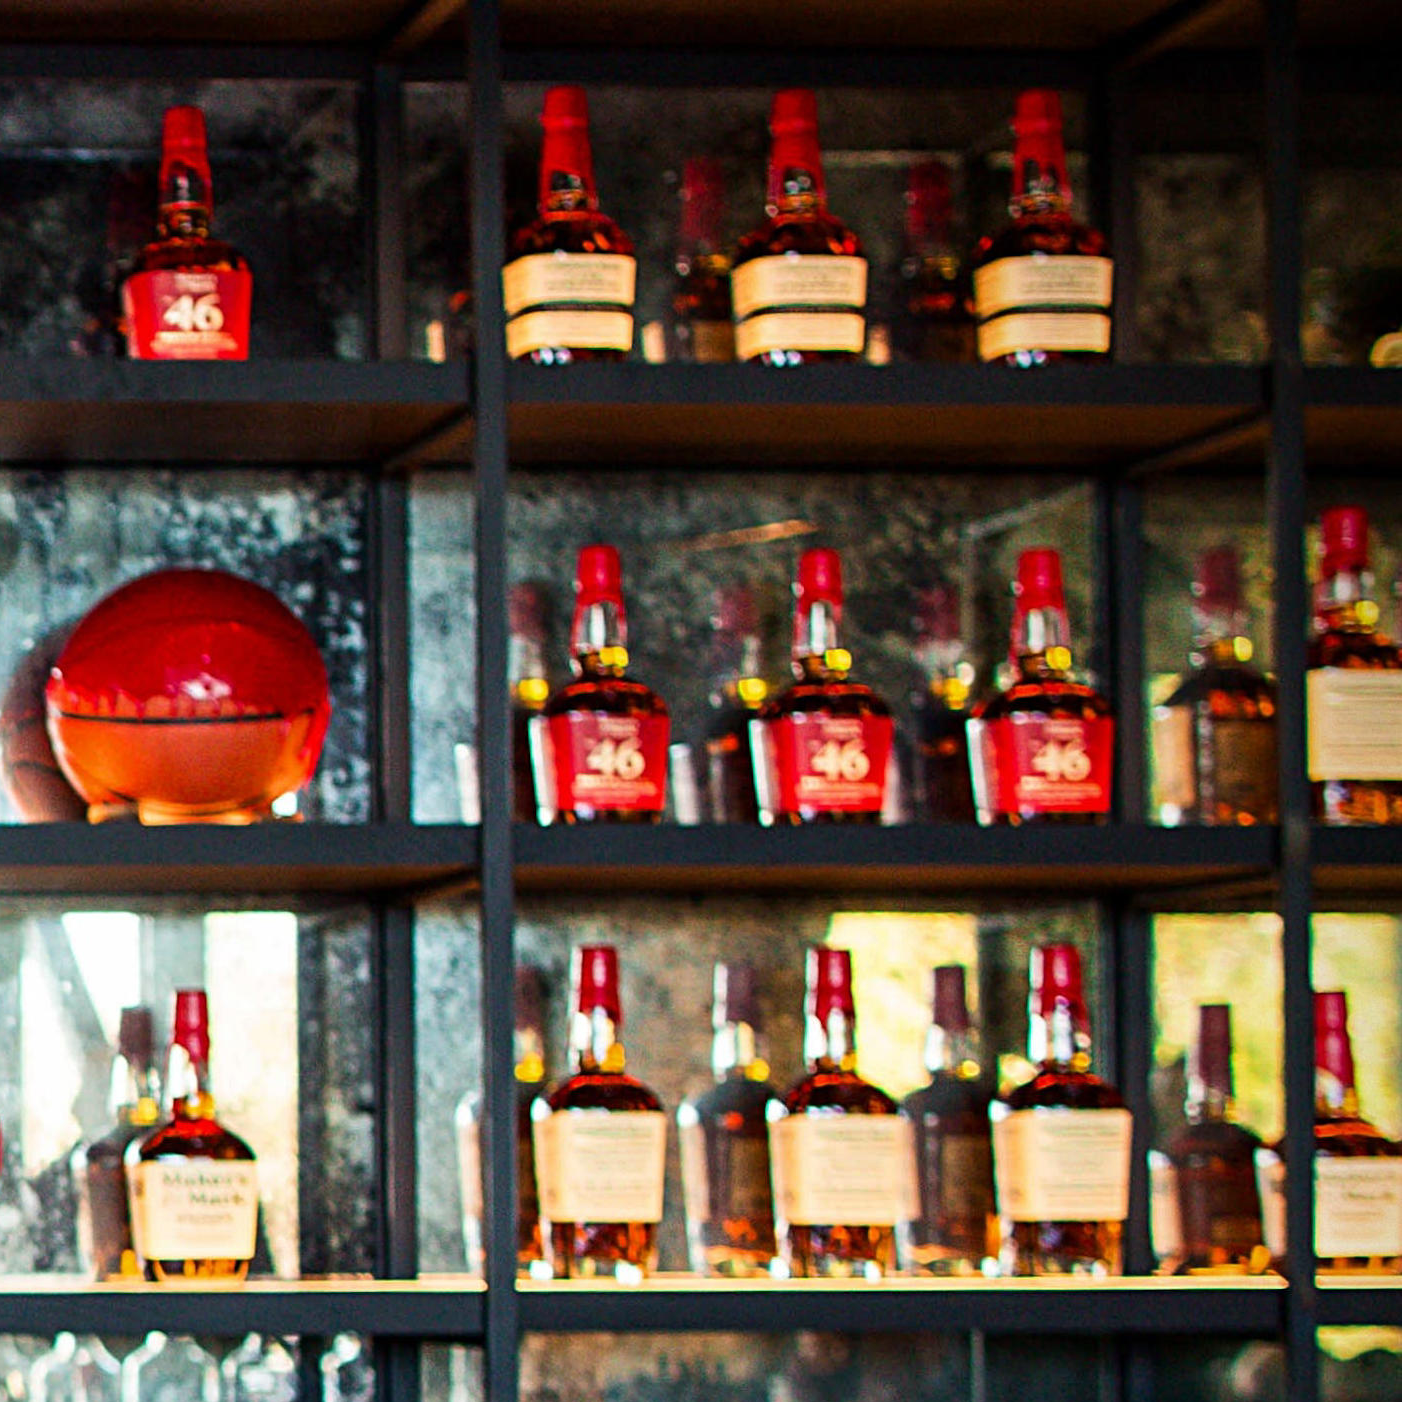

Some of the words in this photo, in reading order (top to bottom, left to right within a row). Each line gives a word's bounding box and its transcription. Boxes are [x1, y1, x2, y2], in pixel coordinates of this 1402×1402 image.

[163, 293, 224, 331] 46
[586, 738, 645, 780] 46
[811, 738, 870, 781] 46
[1031, 739, 1092, 782] 46
